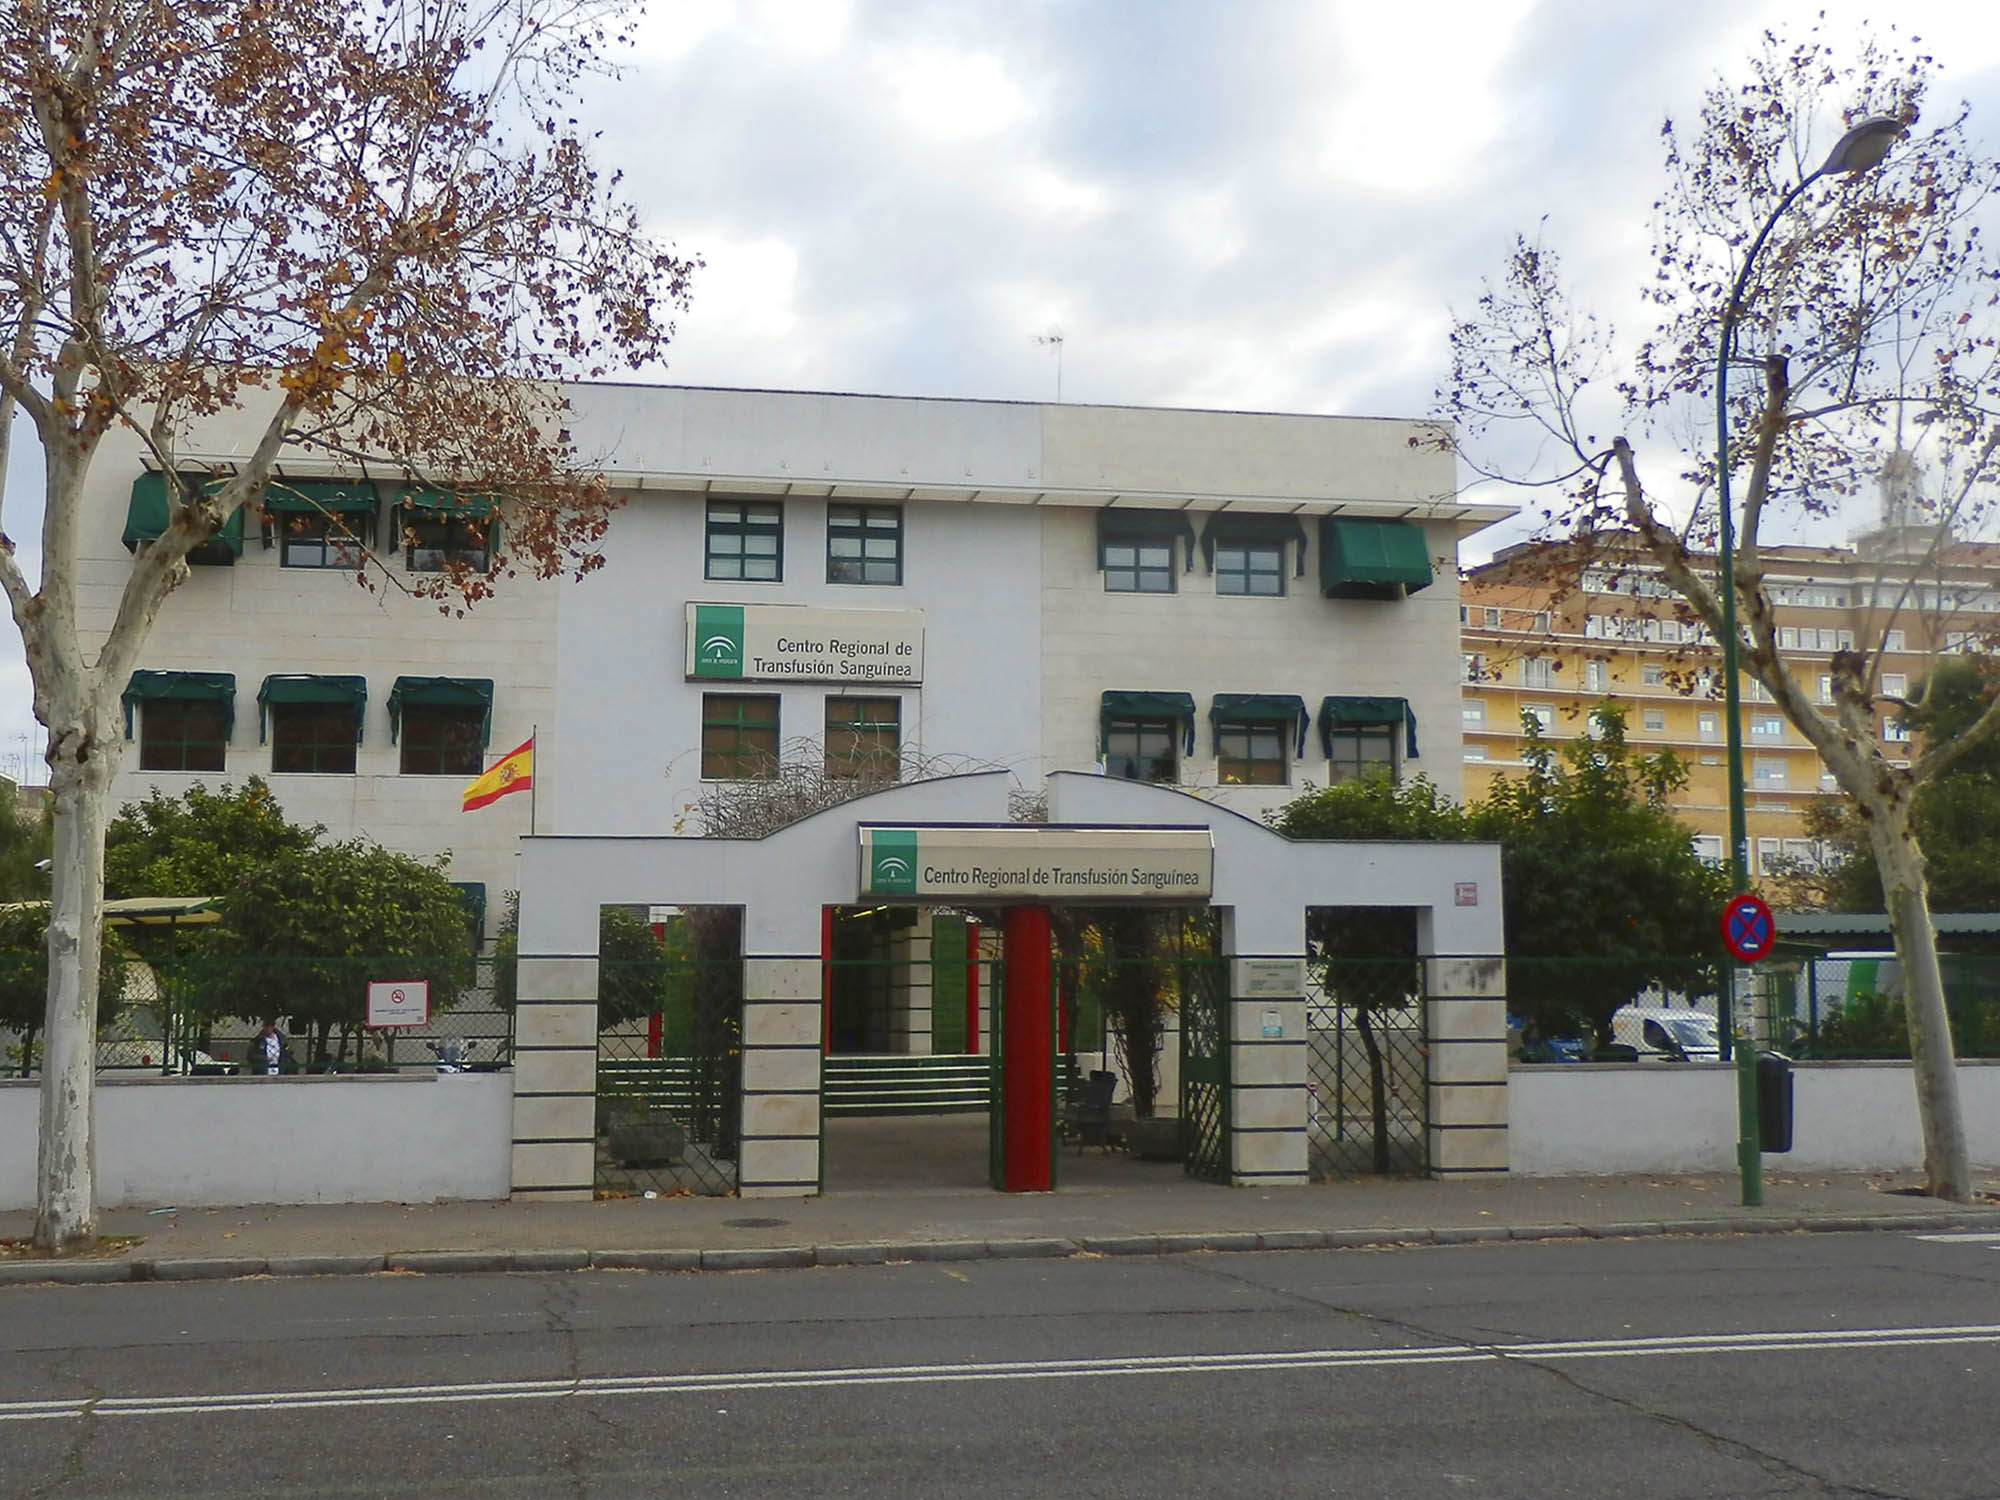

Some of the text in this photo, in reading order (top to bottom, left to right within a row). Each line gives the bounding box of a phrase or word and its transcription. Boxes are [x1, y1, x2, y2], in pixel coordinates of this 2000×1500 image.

[777, 638, 912, 657] Centro Regional de
[753, 657, 912, 679] Transfusión Sanguínea
[924, 866, 1199, 889] Centro Regional de Transfusión Sanguínea
